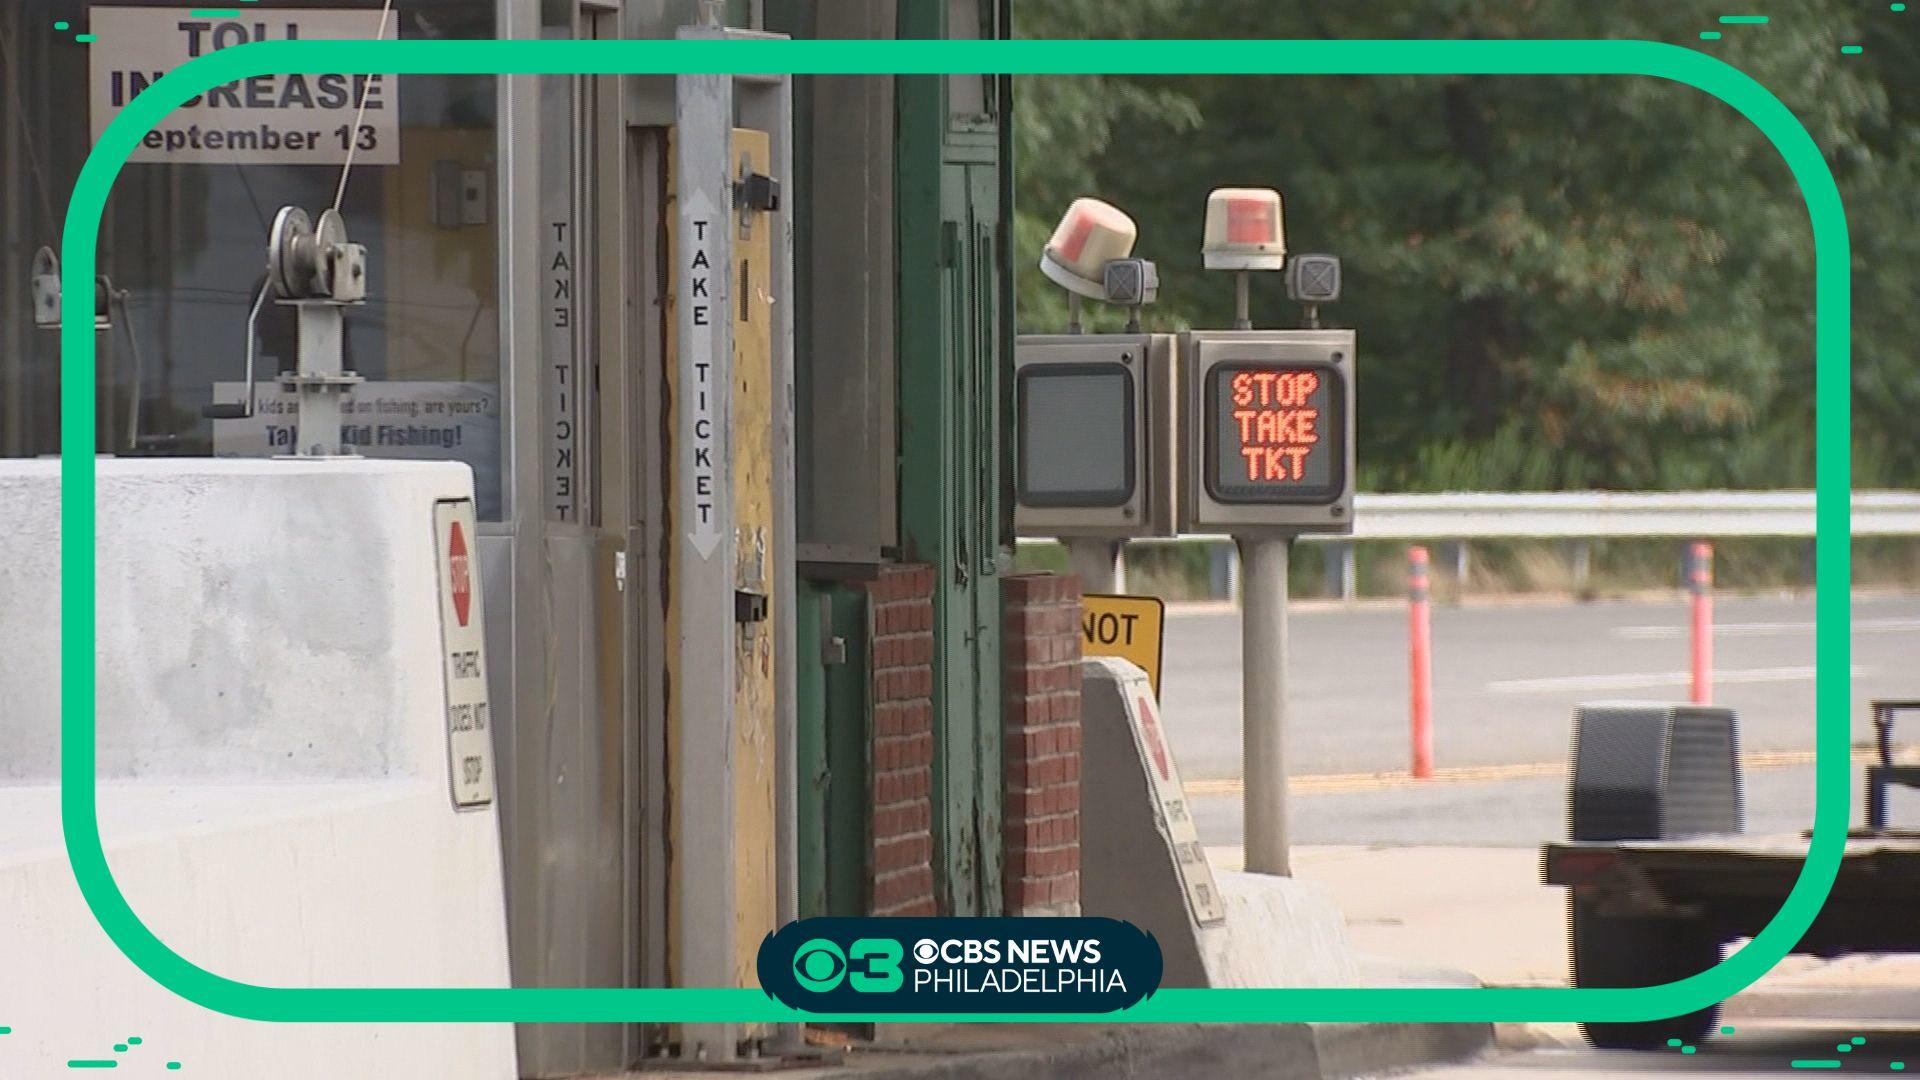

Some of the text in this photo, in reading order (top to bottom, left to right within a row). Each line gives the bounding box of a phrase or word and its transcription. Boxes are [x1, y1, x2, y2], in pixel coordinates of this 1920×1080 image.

[111, 71, 383, 109] INREASE
[137, 124, 377, 151] eptember 13
[691, 221, 712, 523] TAKE TICKET
[1231, 370, 1320, 408] STOP
[448, 398, 488, 417] yours?
[378, 424, 462, 449] Fishing!
[1232, 409, 1319, 444] TAKE
[1241, 446, 1312, 482] TKT
